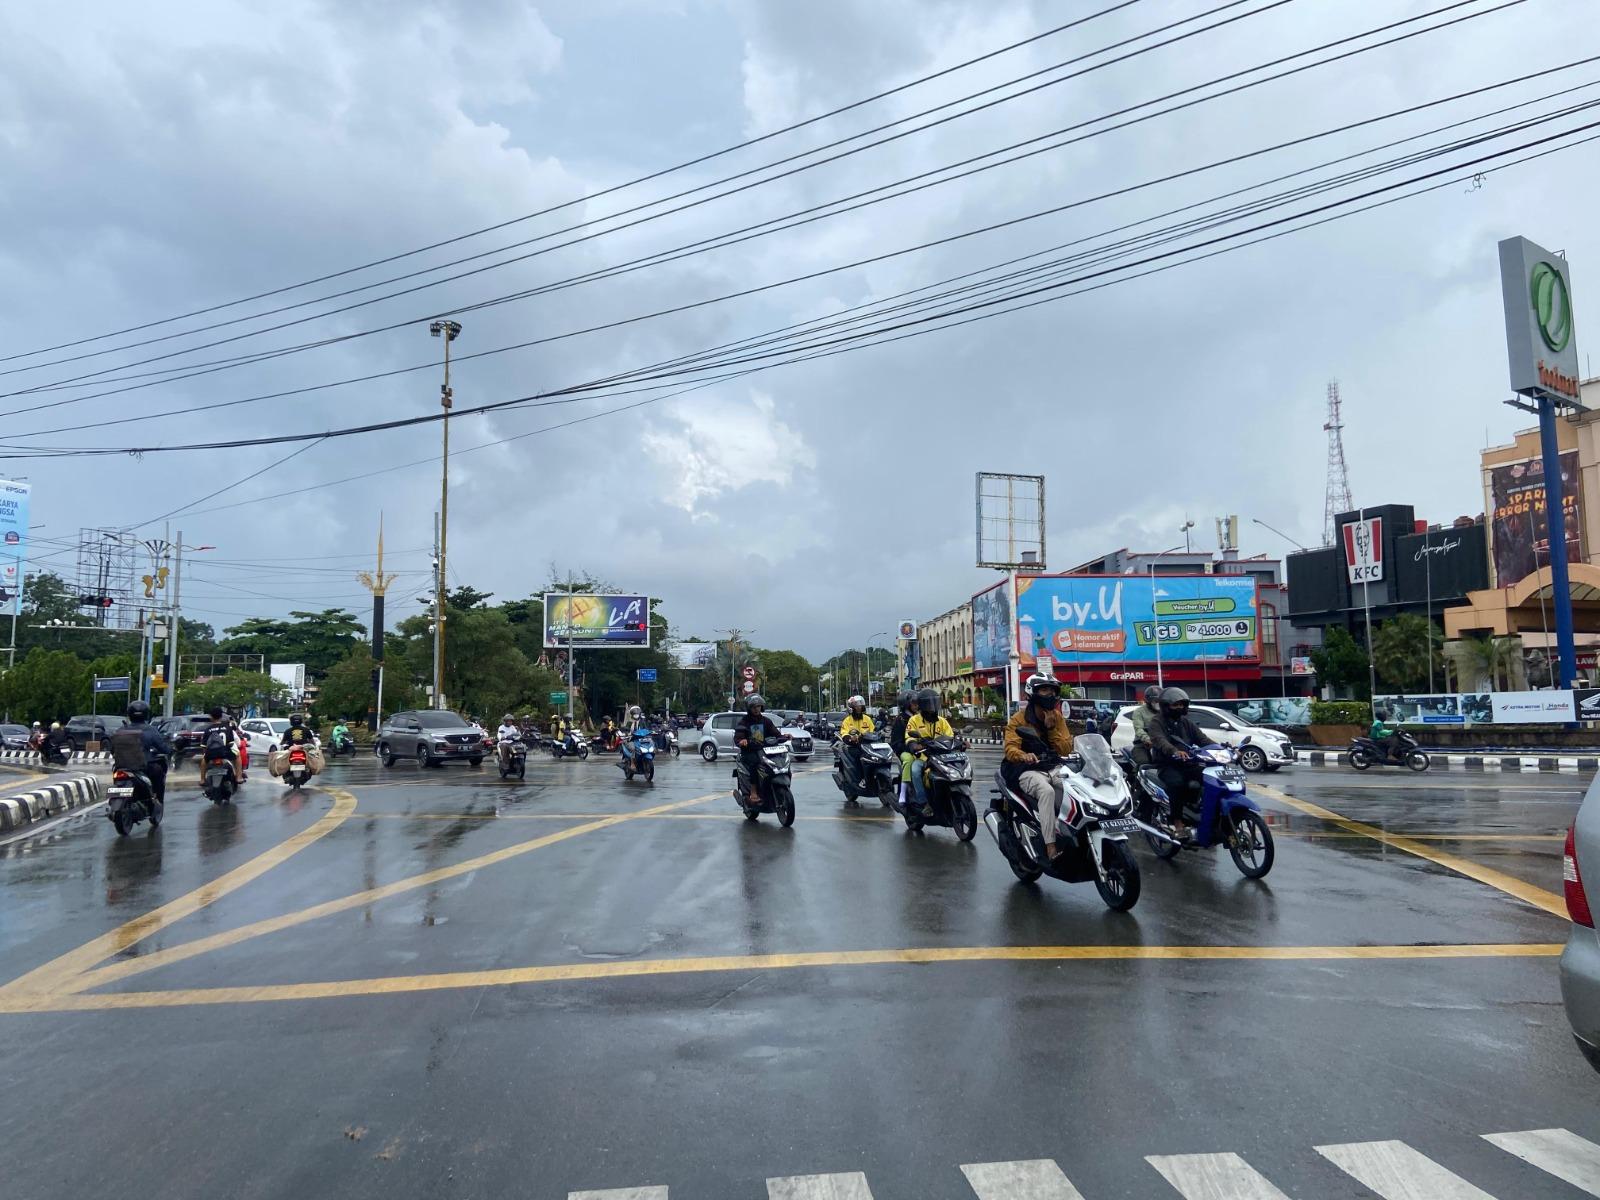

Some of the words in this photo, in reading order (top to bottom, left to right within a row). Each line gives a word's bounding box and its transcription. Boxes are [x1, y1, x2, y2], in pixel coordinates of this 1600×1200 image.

[1354, 565, 1379, 580] KFC
[1052, 580, 1123, 626] by.U
[1199, 624, 1232, 636] 4.000
